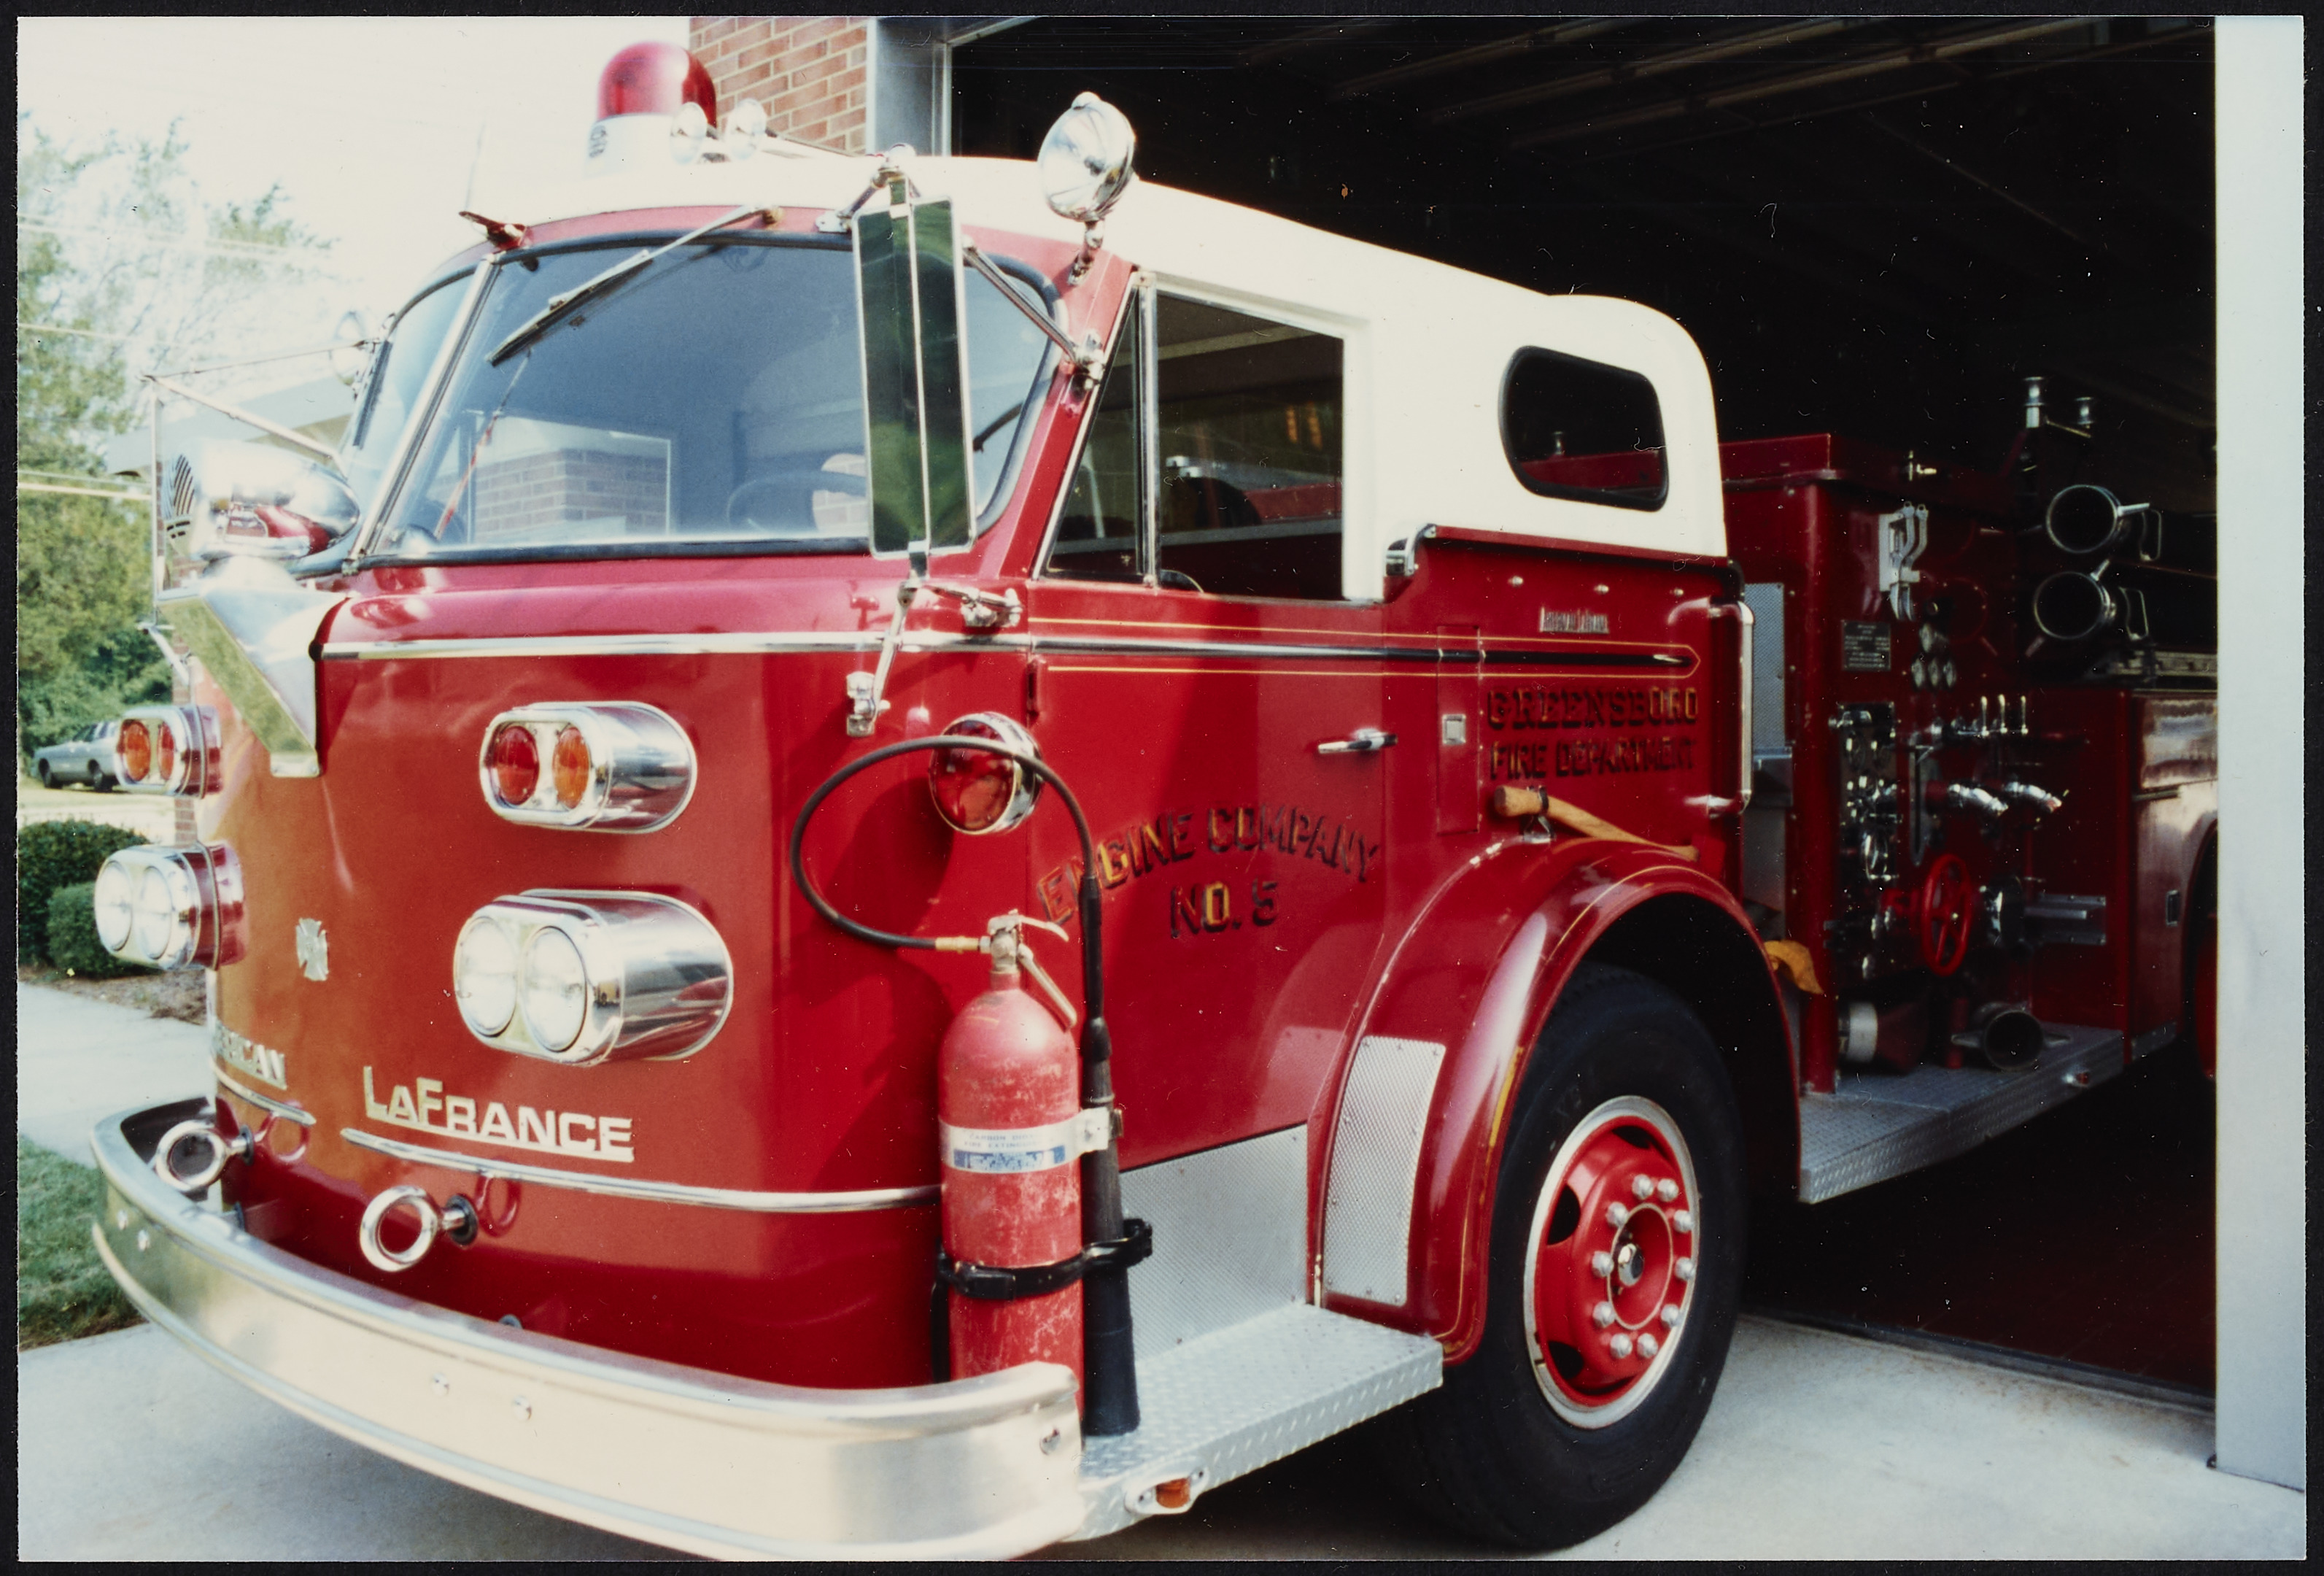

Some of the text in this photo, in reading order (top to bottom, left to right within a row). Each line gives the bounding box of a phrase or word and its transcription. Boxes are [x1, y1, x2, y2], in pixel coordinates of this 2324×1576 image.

[1487, 686, 1698, 729] GREENSBORO
[1490, 739, 1547, 779] FIRE
[1208, 804, 1379, 882] COMPANY
[1170, 878, 1279, 939] NO. 5
